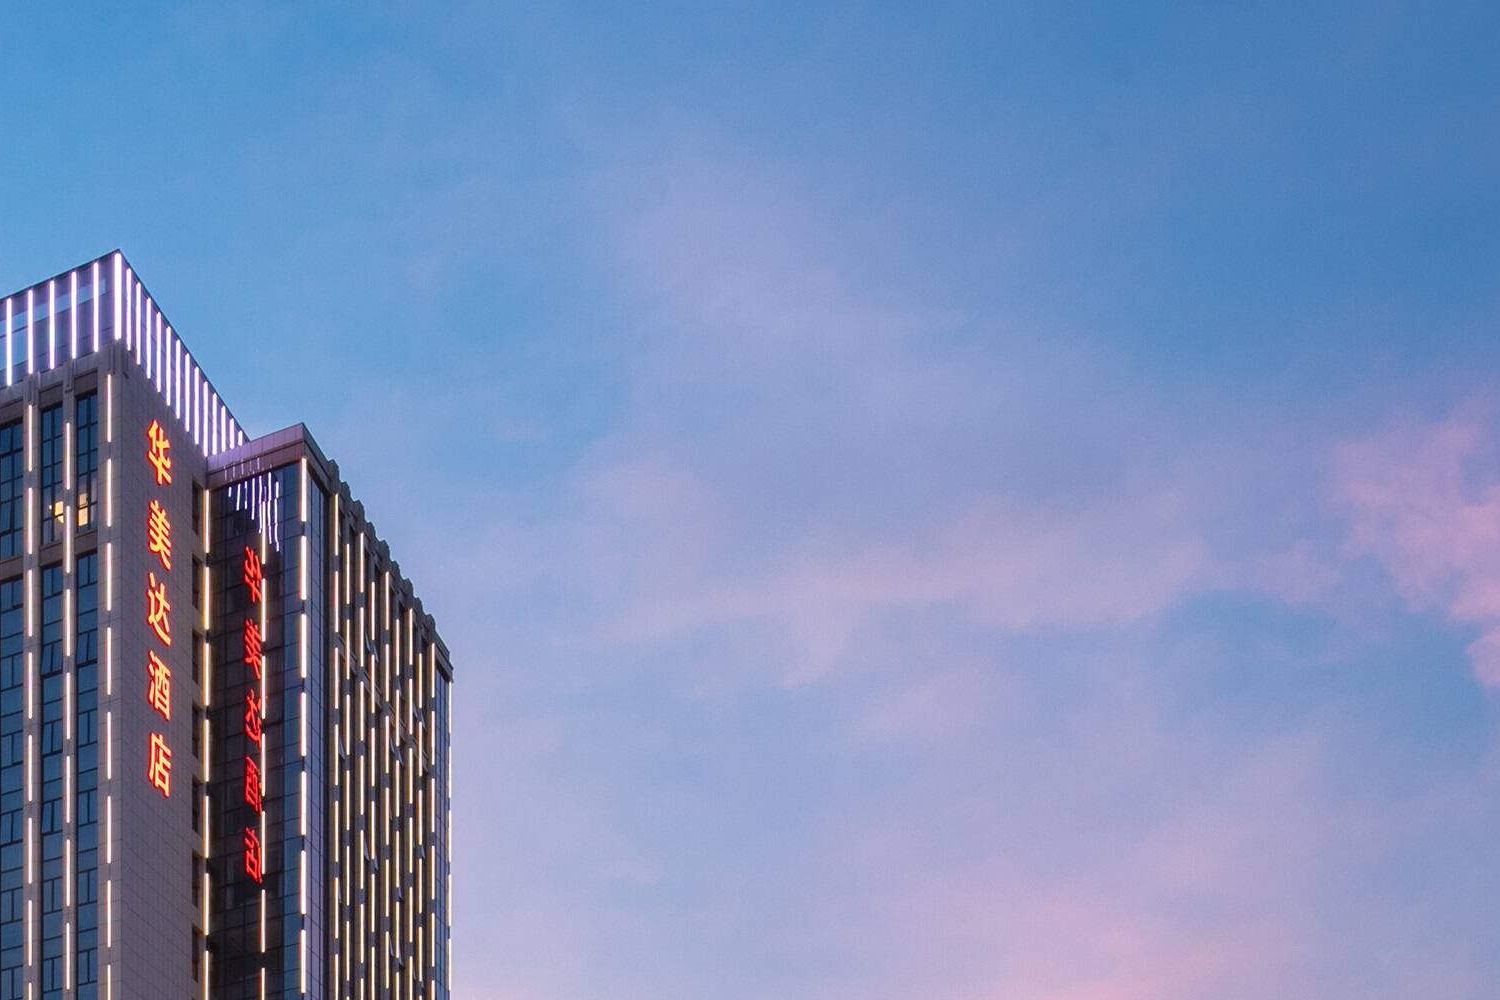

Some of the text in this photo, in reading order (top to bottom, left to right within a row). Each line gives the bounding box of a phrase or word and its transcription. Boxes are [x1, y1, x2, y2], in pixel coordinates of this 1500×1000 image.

[148, 419, 171, 797] 华美达酒店
